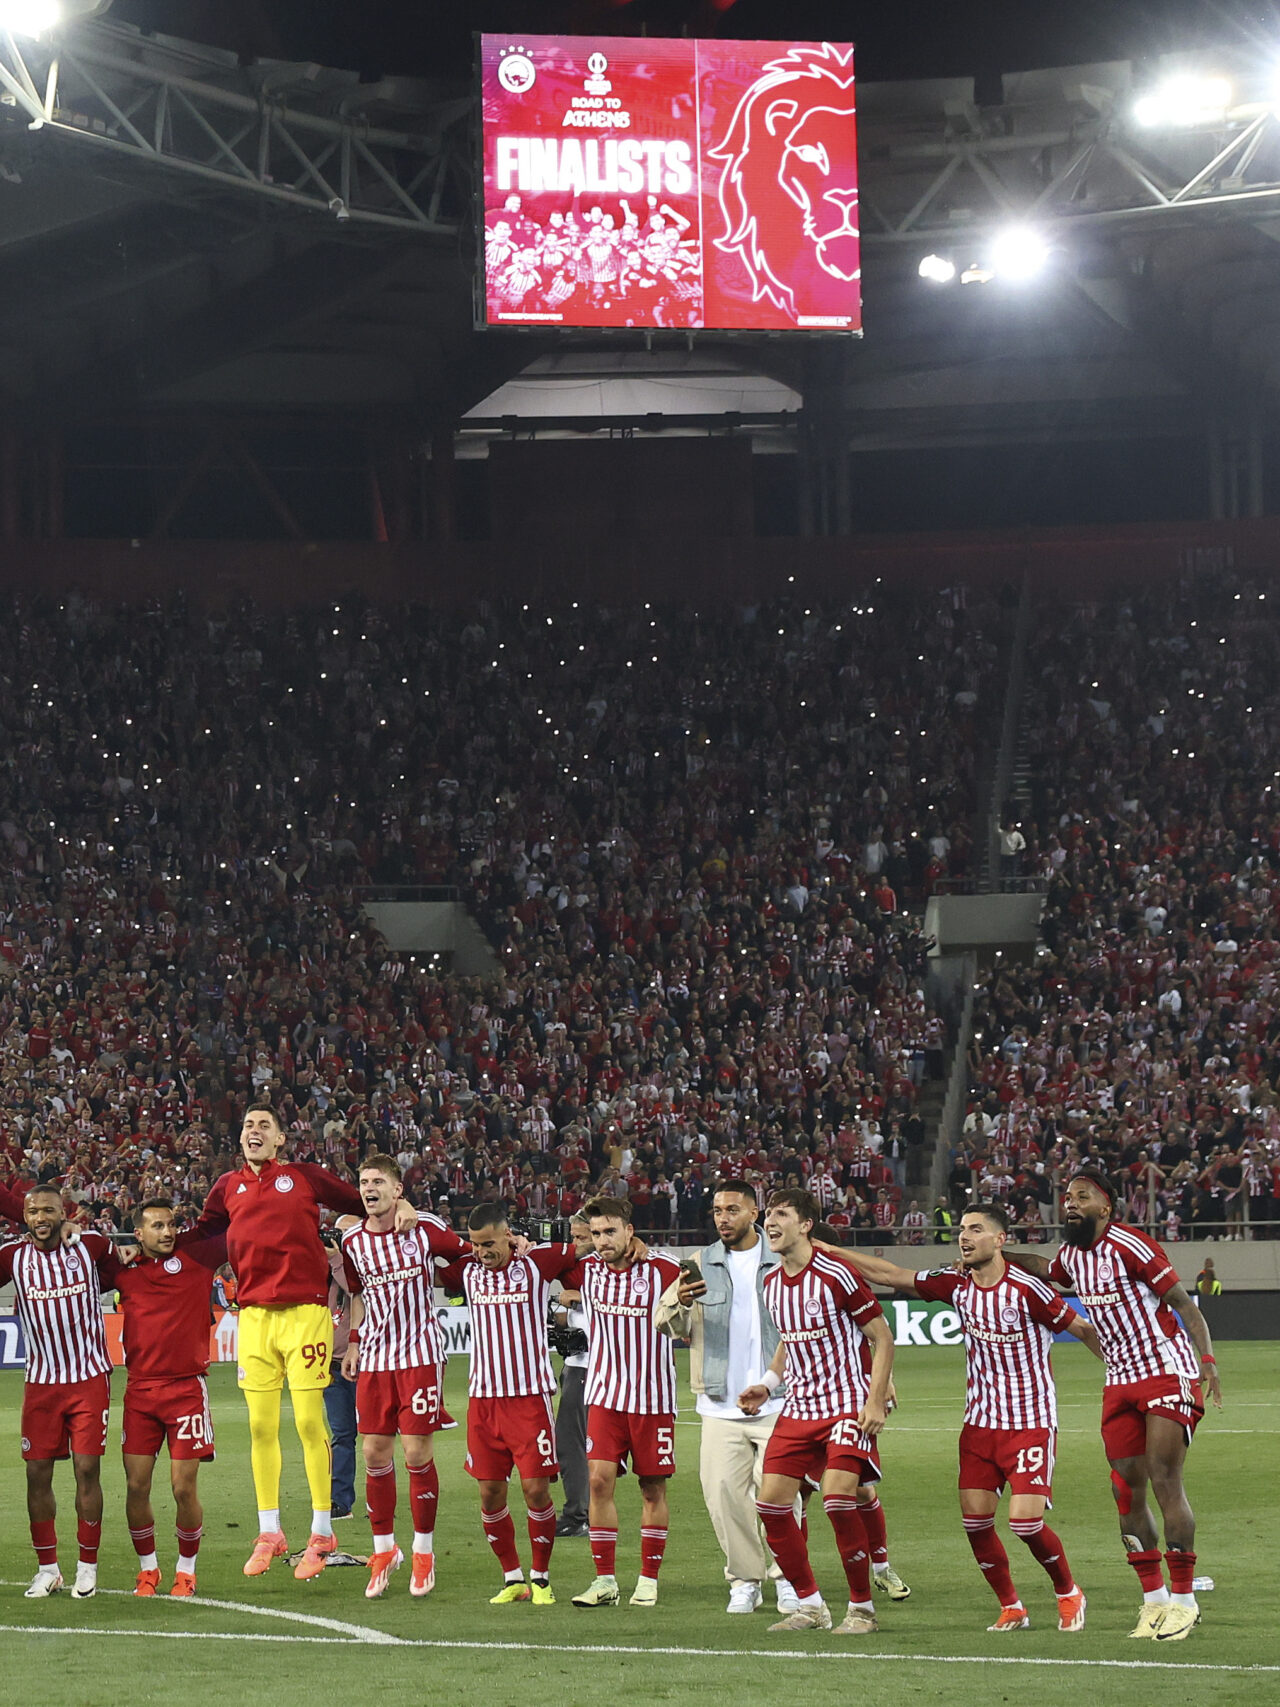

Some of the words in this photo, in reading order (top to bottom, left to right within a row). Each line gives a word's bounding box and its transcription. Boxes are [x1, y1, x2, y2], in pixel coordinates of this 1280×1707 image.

[571, 97, 604, 108] ROAD
[605, 98, 621, 109] TO
[562, 110, 631, 128] ATHENS
[496, 137, 692, 194] FINALISTS
[365, 1266, 422, 1287] Stoiximan
[27, 1282, 87, 1300] Stoiximan
[472, 1291, 529, 1305] Stoiximan
[593, 1299, 648, 1316] Stoiximan
[302, 1342, 327, 1369] 99
[411, 1386, 439, 1415] 65
[176, 1414, 204, 1440] 20
[829, 1419, 860, 1446] 45
[537, 1429, 552, 1456] 6
[657, 1428, 672, 1455] 5
[1017, 1446, 1044, 1473] 19
